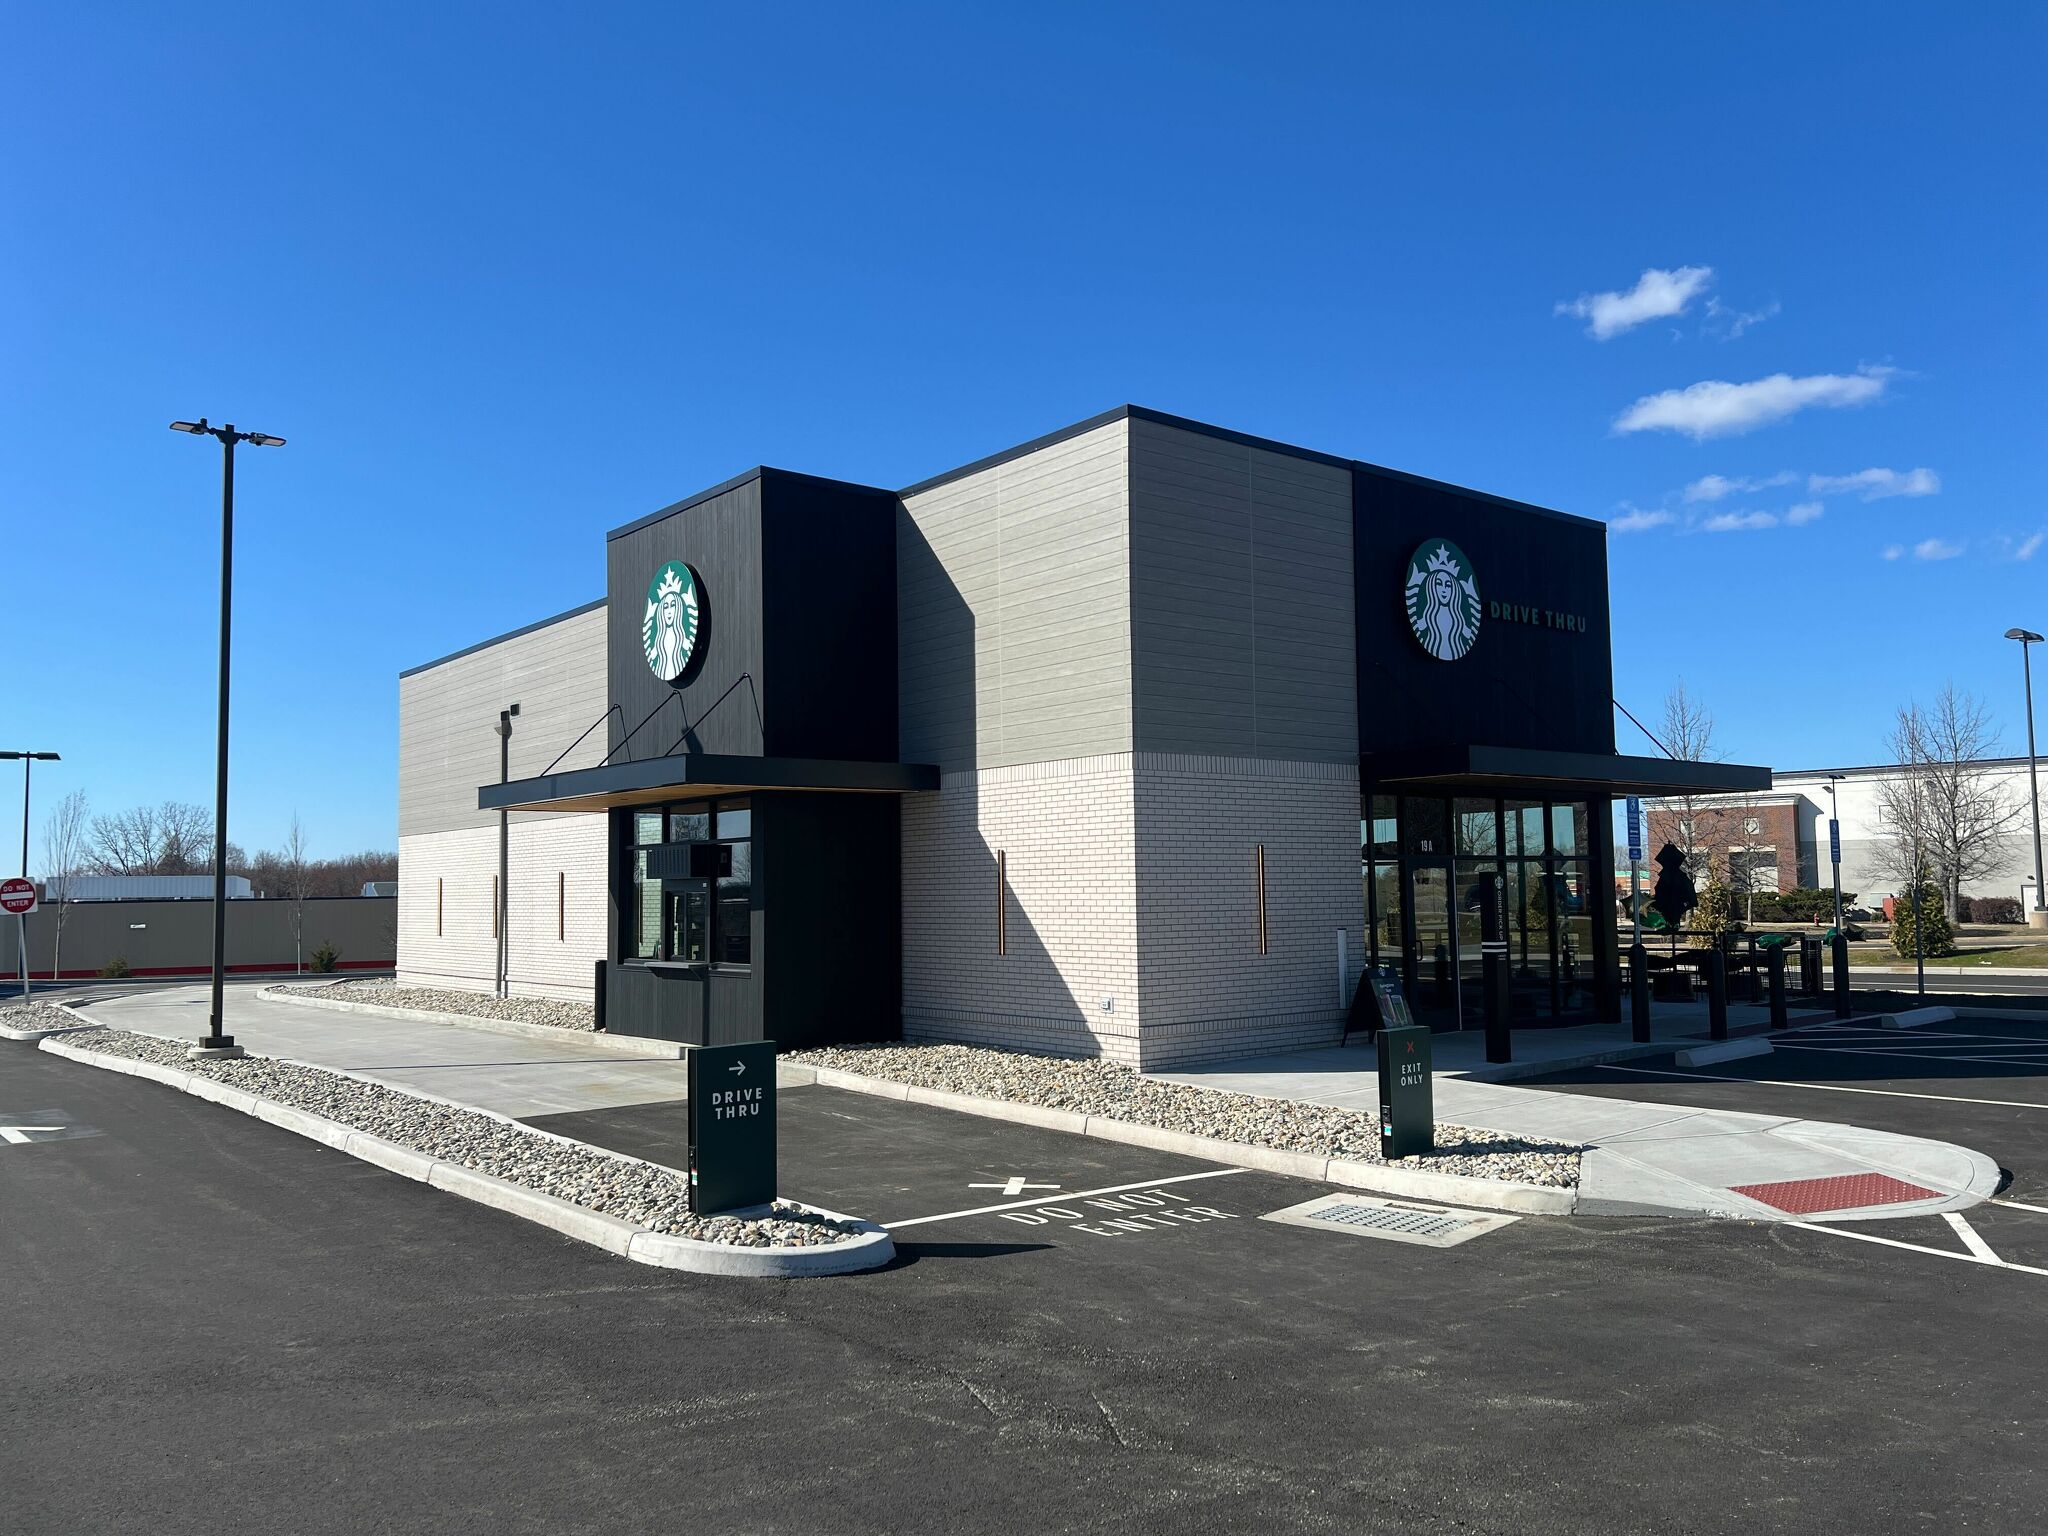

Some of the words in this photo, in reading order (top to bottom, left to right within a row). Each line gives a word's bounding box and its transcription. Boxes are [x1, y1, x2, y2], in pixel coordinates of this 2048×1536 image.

[1490, 600, 1540, 625] DRIVE
[1545, 610, 1586, 633] THRU
[6, 900, 29, 908] ENTER
[1498, 930, 1504, 941] UP
[1401, 1062, 1421, 1074] EXIT
[1400, 1074, 1423, 1086] ONLY
[712, 1087, 762, 1105] DRIVE
[715, 1103, 759, 1120] THRU
[998, 1207, 1084, 1225] DO
[1083, 1189, 1191, 1212] NOT
[1069, 1206, 1241, 1236] ENTER
